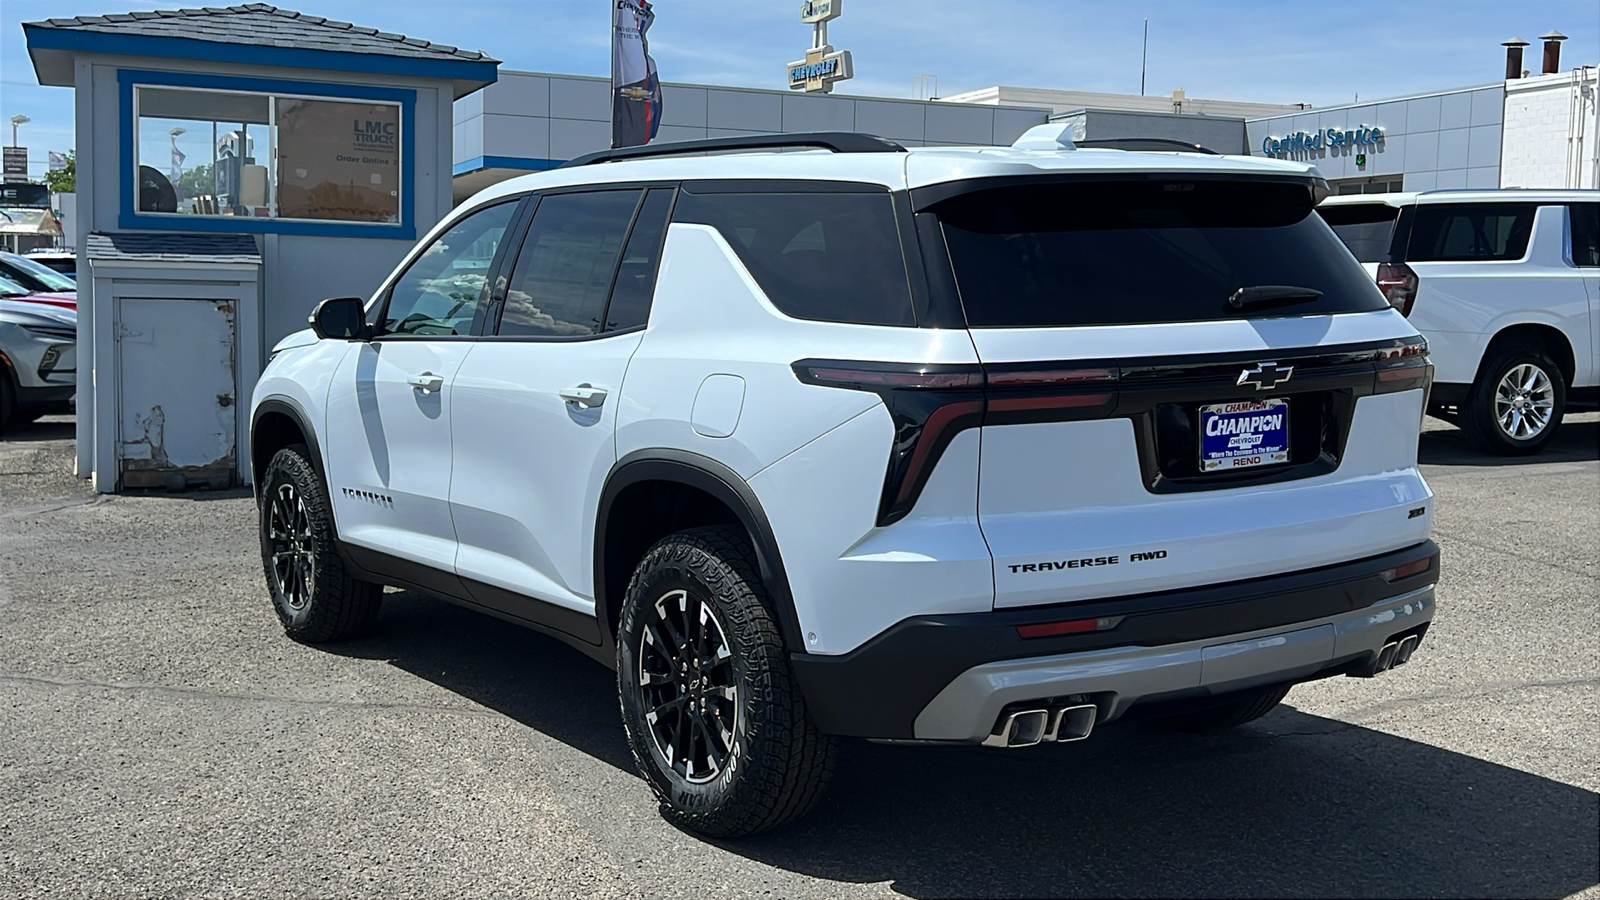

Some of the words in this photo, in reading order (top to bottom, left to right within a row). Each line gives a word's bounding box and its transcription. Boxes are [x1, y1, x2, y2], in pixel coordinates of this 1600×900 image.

[791, 60, 836, 79] CHEVROLET
[353, 120, 394, 135] LMC
[353, 133, 394, 144] TRUCK
[1263, 128, 1322, 154] Certified
[1326, 124, 1380, 147] Service
[336, 155, 360, 163] Order
[362, 157, 389, 165] Online
[1225, 401, 1267, 413] CHAMPION
[1206, 414, 1282, 437] CHAMPION
[1230, 436, 1261, 445] CHEVROLET
[1233, 456, 1261, 466] RENO
[1008, 555, 1119, 573] TRAVERSE
[1130, 550, 1168, 562] AWD
